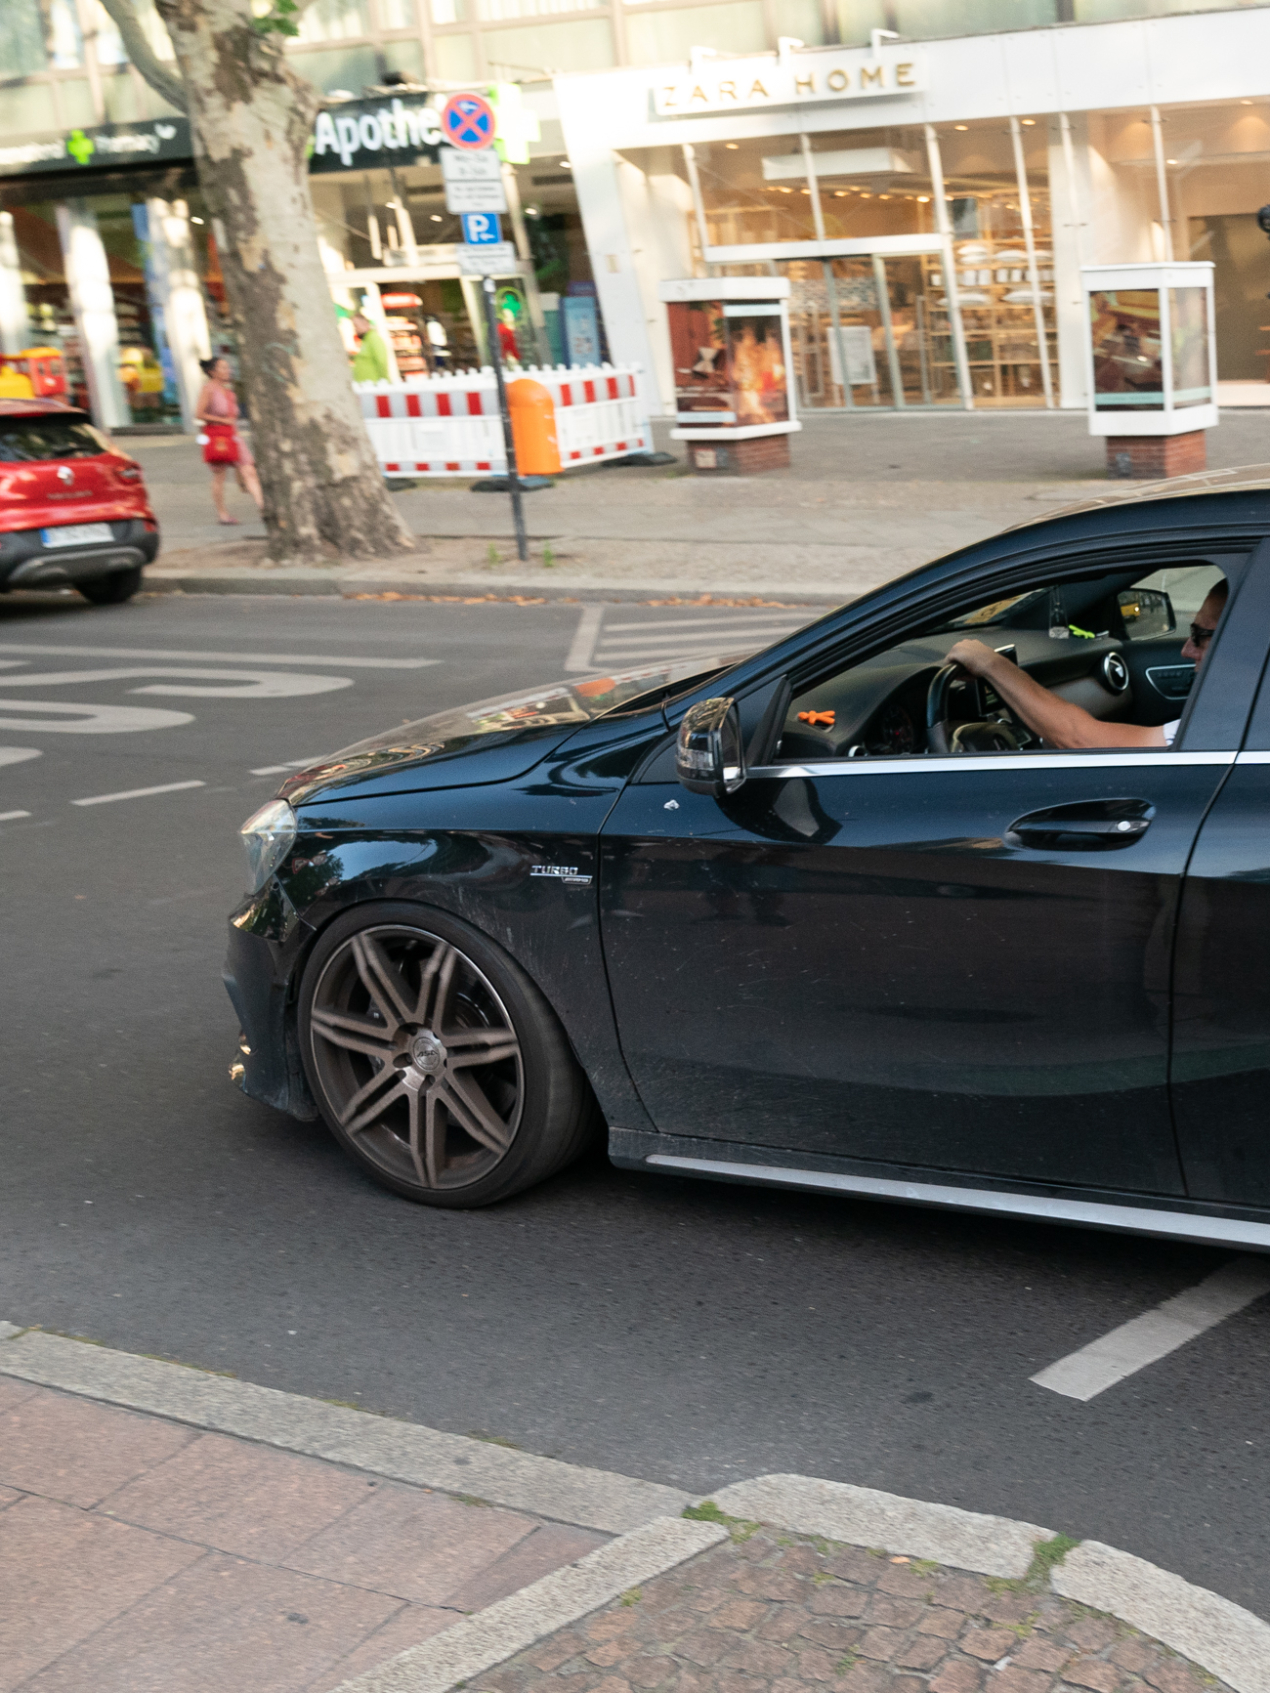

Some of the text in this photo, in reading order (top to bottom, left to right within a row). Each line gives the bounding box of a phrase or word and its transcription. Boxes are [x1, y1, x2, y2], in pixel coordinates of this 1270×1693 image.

[663, 62, 916, 107] ZARA HOME
[315, 94, 449, 166] Apothe
[467, 214, 490, 243] P
[531, 865, 579, 876] TURBO
